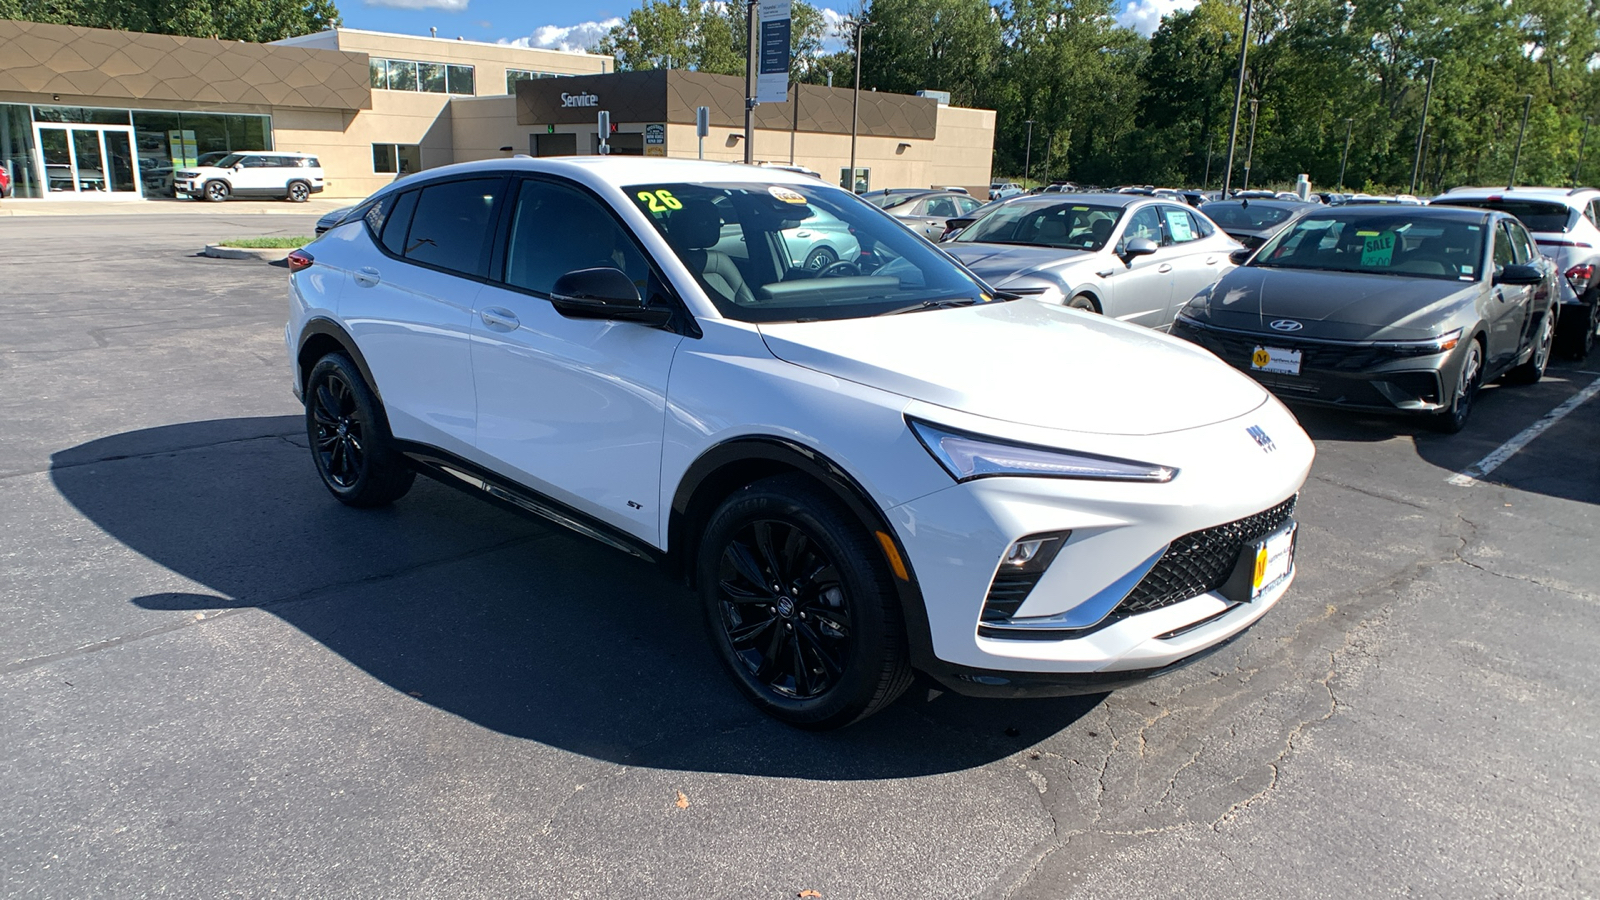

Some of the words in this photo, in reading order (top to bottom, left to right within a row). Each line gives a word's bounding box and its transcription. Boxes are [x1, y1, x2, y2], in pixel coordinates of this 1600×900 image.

[561, 91, 598, 107] Service
[638, 190, 683, 212] 26
[1366, 237, 1392, 253] SALE
[1256, 353, 1268, 364] M
[627, 500, 643, 510] ST
[1255, 556, 1267, 582] M
